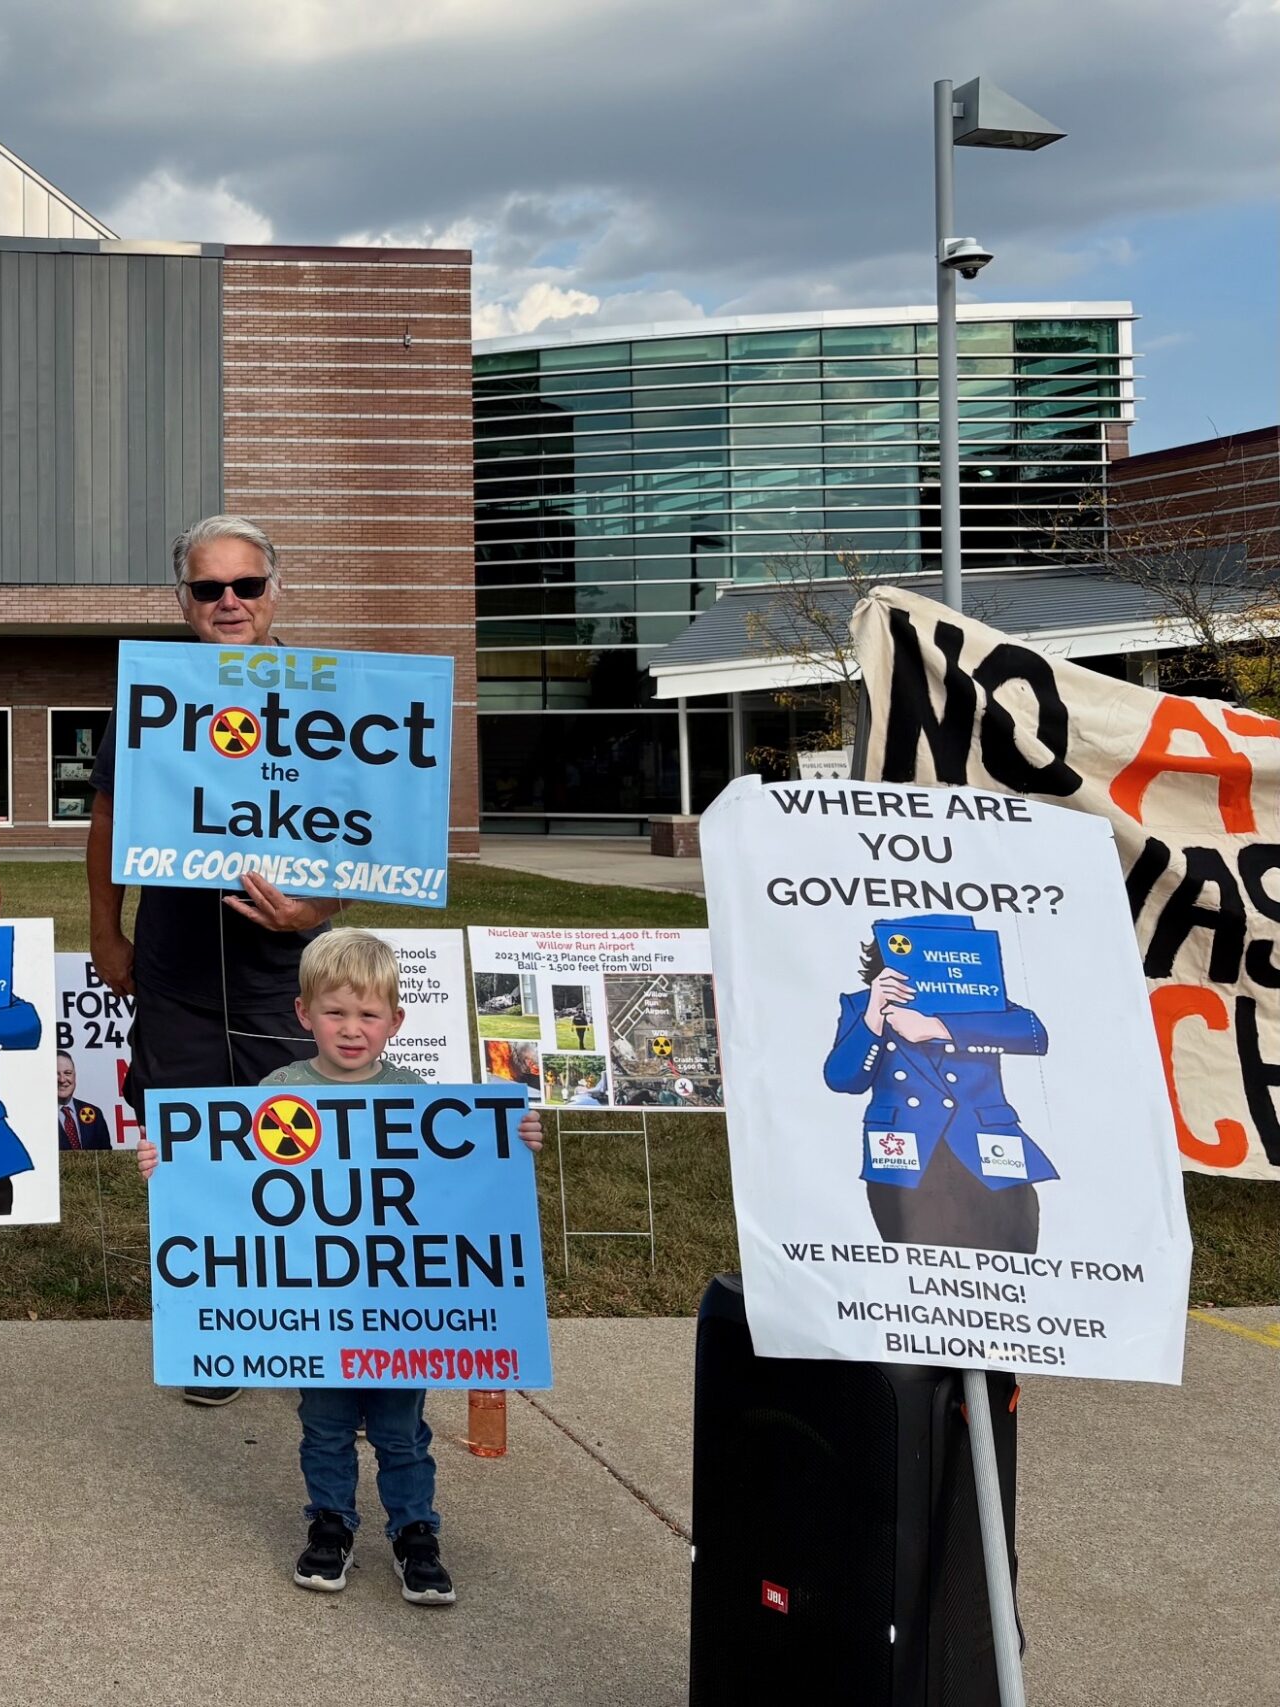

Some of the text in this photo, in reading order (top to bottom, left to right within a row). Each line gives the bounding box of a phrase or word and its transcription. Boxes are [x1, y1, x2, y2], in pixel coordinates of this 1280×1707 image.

[218, 651, 338, 692] EGLE
[881, 607, 1083, 796] NO
[260, 762, 300, 782] the
[770, 789, 1033, 823] WHERE ARE
[193, 787, 373, 846] Lakes
[858, 832, 953, 864] YOU
[123, 847, 445, 900] FOR GOODNESS SAKES!!
[766, 877, 1065, 916] GOVERNOR??
[488, 929, 528, 938] Nuclear
[531, 931, 562, 939] waste
[564, 930, 573, 939] is
[575, 930, 609, 939] stored
[655, 930, 681, 939] from
[394, 948, 437, 959] chools
[536, 941, 635, 952] Willow Run Airport
[495, 952, 675, 962] 2023 MIG-23 Plance Crash and Fire
[517, 962, 538, 970] Ball
[578, 962, 599, 971] feet
[602, 962, 627, 971] from
[629, 963, 653, 971] WDI
[923, 950, 982, 965] WHERE
[399, 962, 427, 974] lose
[947, 967, 963, 979] IS
[427, 978, 441, 989] to
[915, 981, 999, 997] WHITMER?
[388, 1035, 447, 1047] Licensed
[380, 1051, 439, 1065] Daycares
[872, 1157, 917, 1166] REPUBLIC
[252, 1168, 419, 1227] OUR
[156, 1234, 525, 1288] CHILDREN!
[782, 1243, 1144, 1283] WE NEED REAL POLICY FROM
[908, 1275, 1026, 1304] LANSING!
[199, 1308, 497, 1332] ENOUGH IS ENOUGH!
[837, 1301, 1107, 1339] MICHIGANDERS OVER
[193, 1348, 519, 1381] NO MORE EXPANSIONS!
[766, 1588, 784, 1606] JBL
